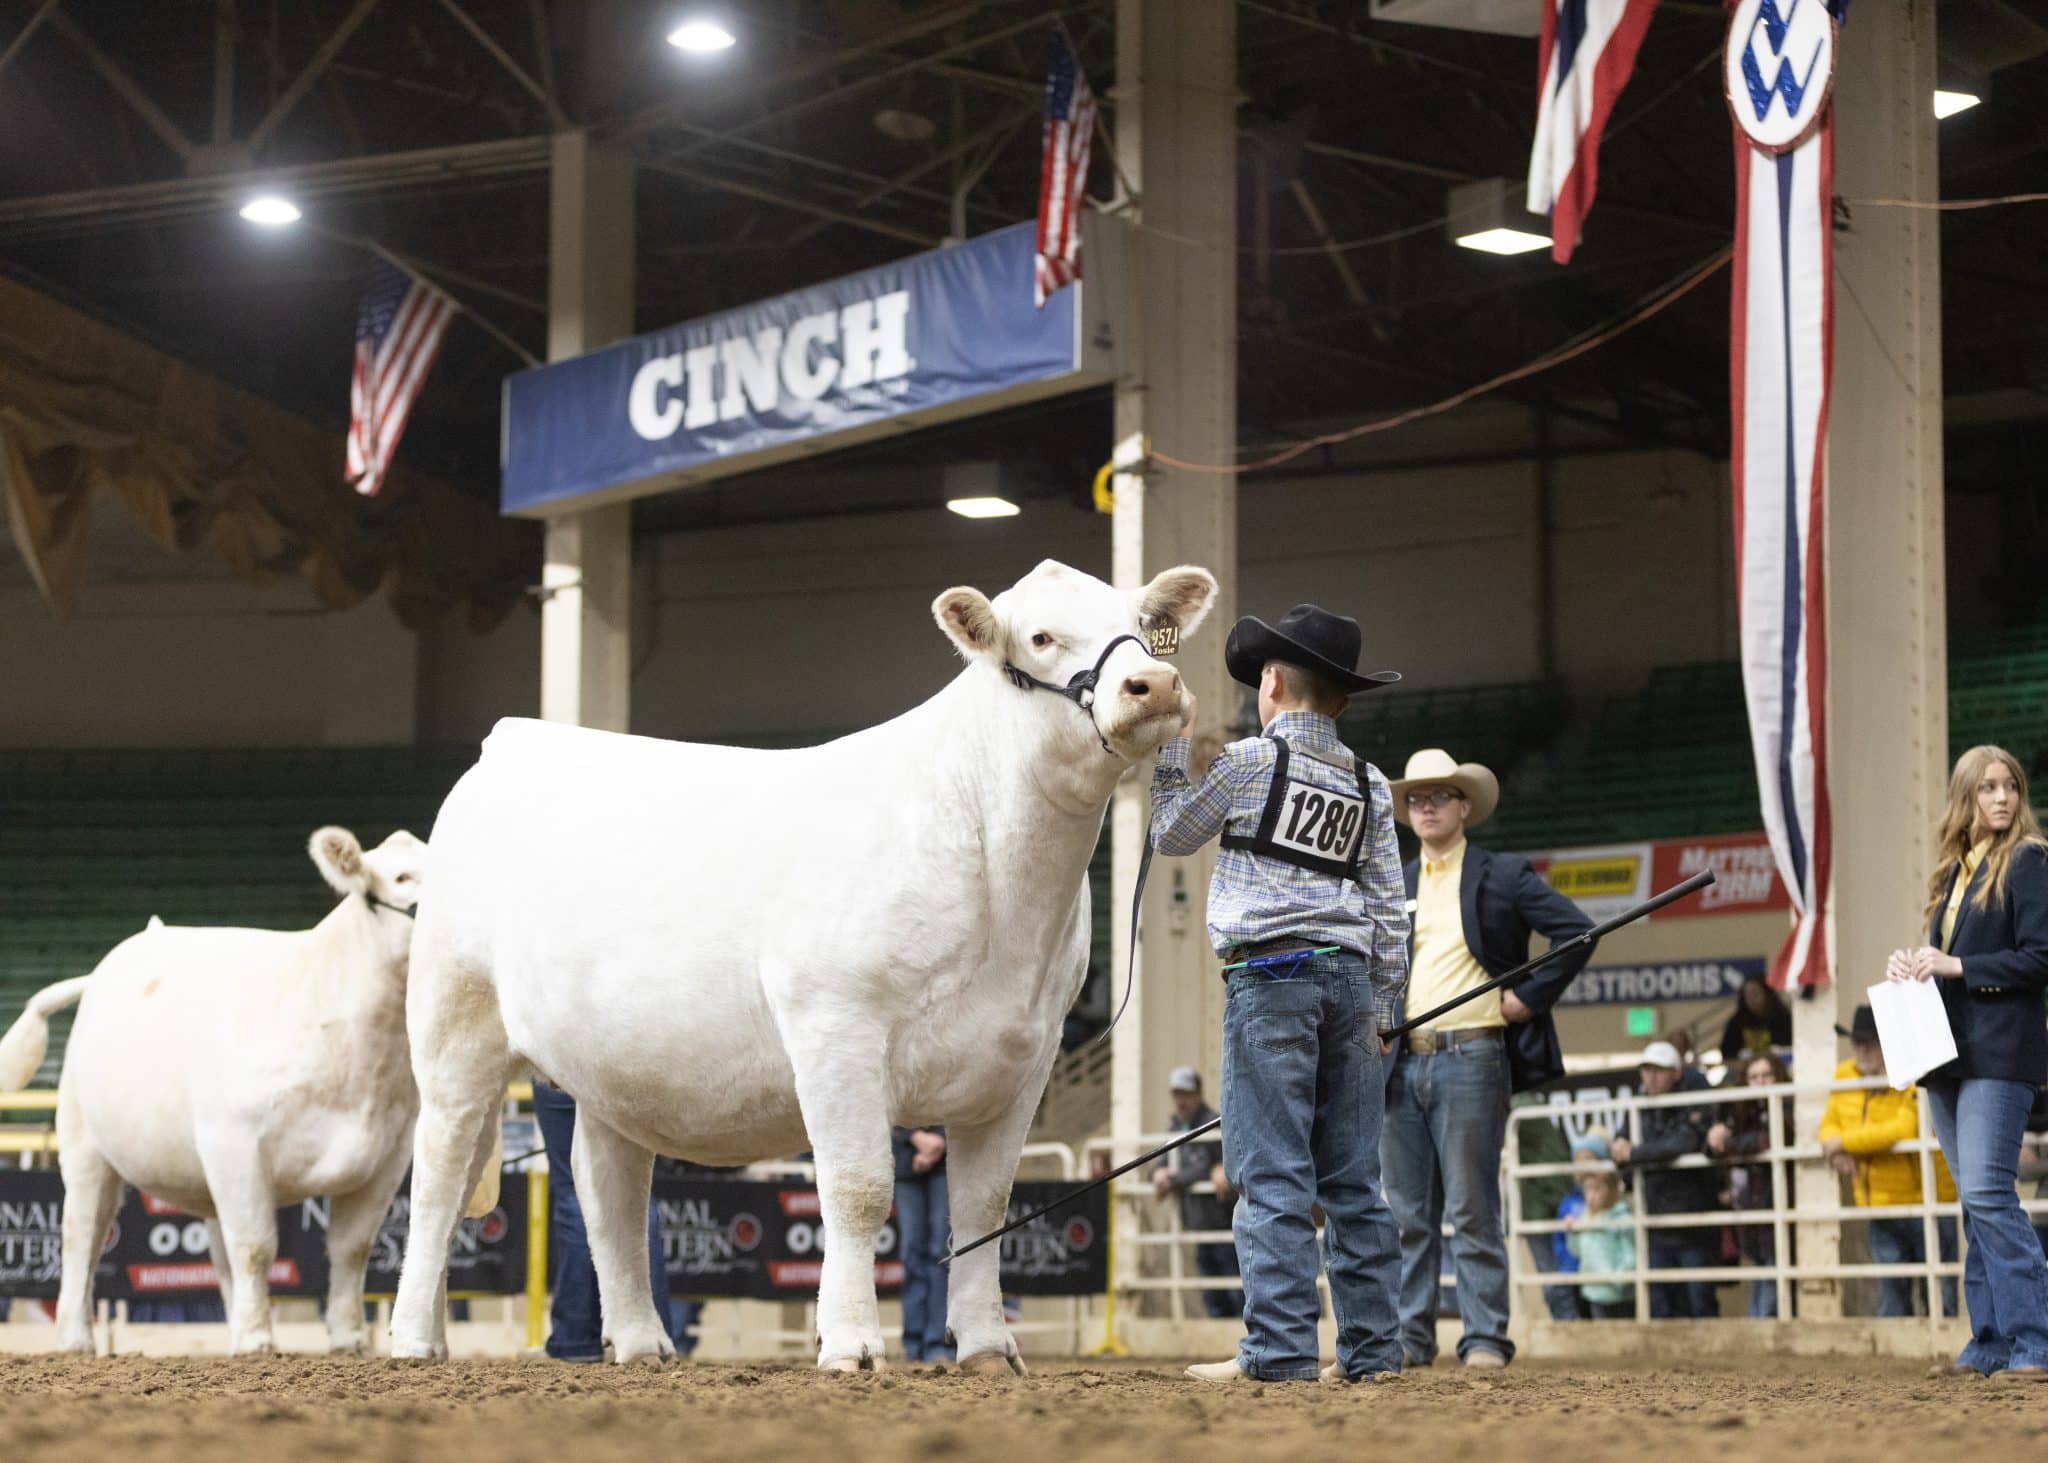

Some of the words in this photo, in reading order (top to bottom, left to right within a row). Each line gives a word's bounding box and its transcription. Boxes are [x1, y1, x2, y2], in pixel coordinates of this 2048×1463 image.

[628, 290, 910, 441] CINCH
[1152, 626, 1178, 647] 957J
[1153, 646, 1175, 655] Josie
[1284, 790, 1360, 856] 1289
[1559, 964, 1722, 1001] ESTROOMS
